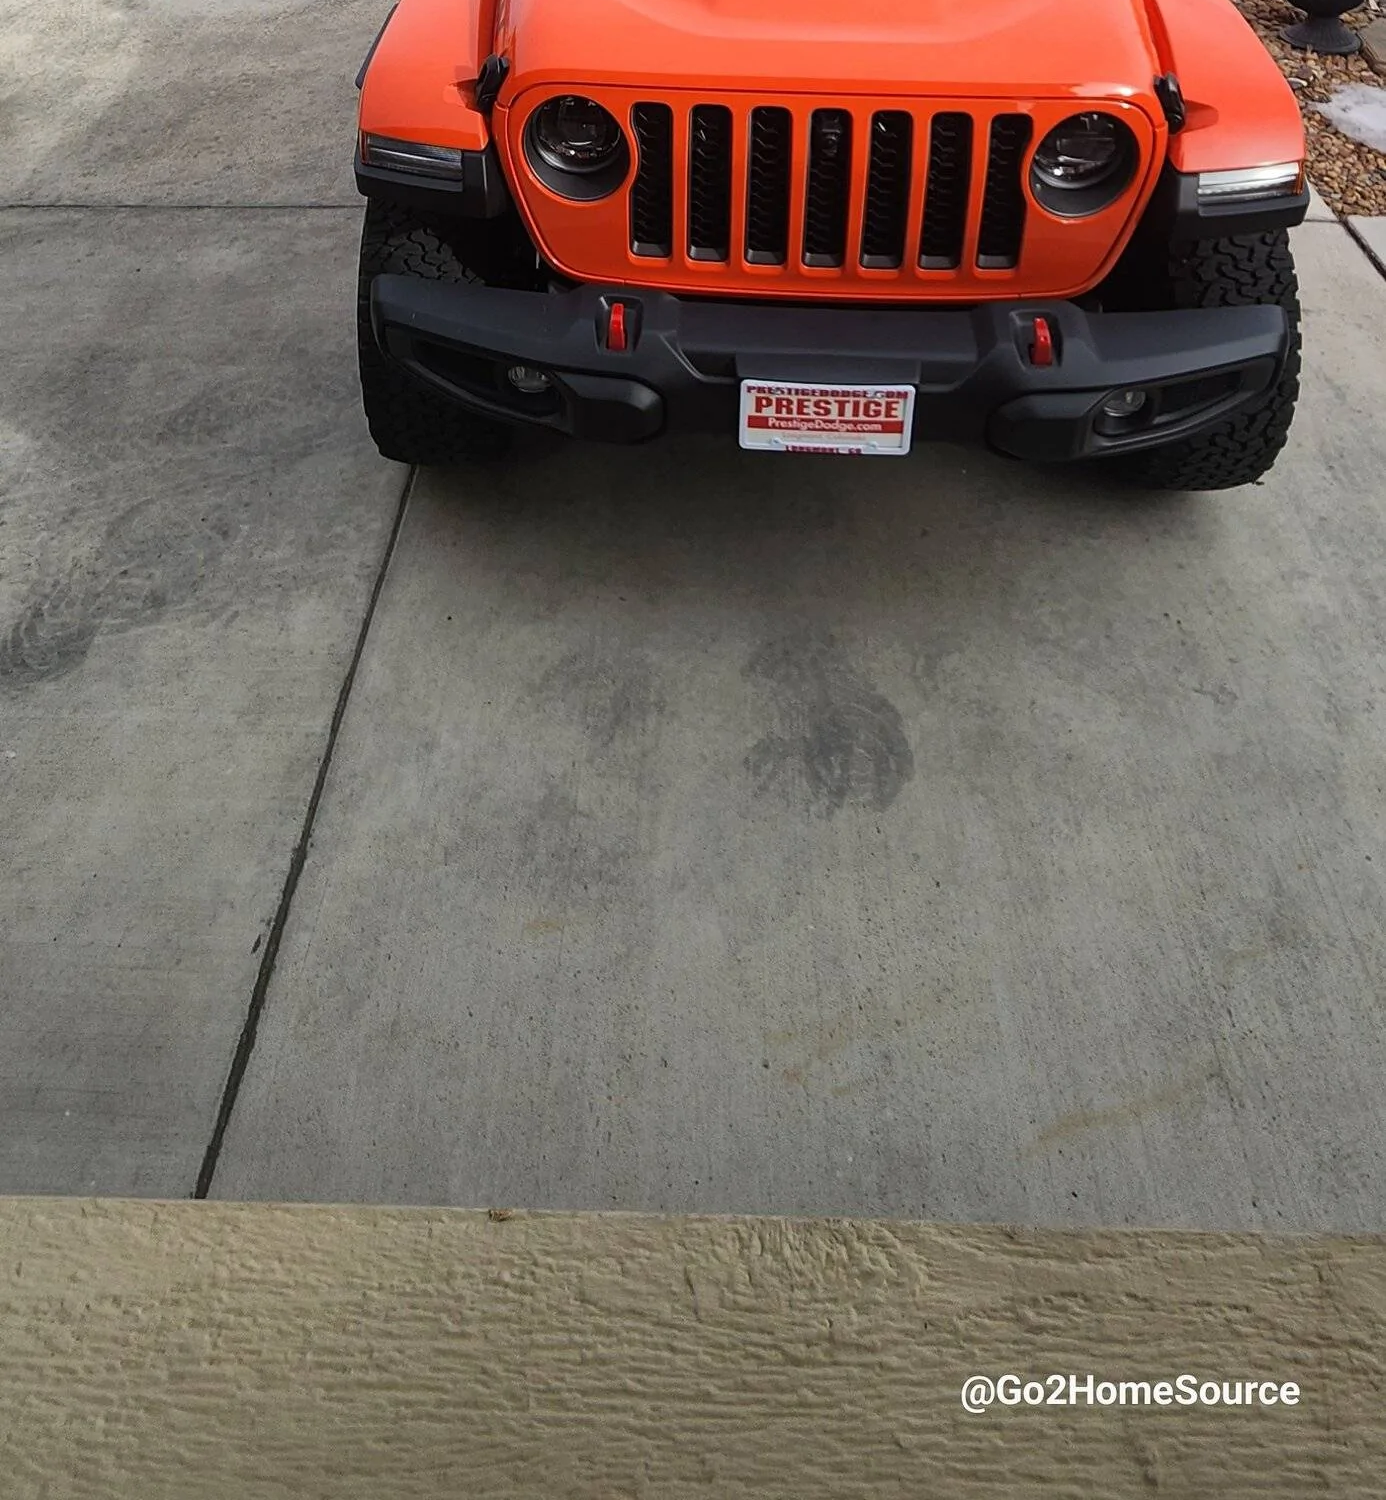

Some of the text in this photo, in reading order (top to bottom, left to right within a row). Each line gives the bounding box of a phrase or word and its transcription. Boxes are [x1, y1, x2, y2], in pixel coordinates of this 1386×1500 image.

[746, 385, 909, 399] PRESTIGEDODGECOM
[755, 396, 899, 418] PRESTIGE
[768, 417, 882, 433] PrestigeDodge.com
